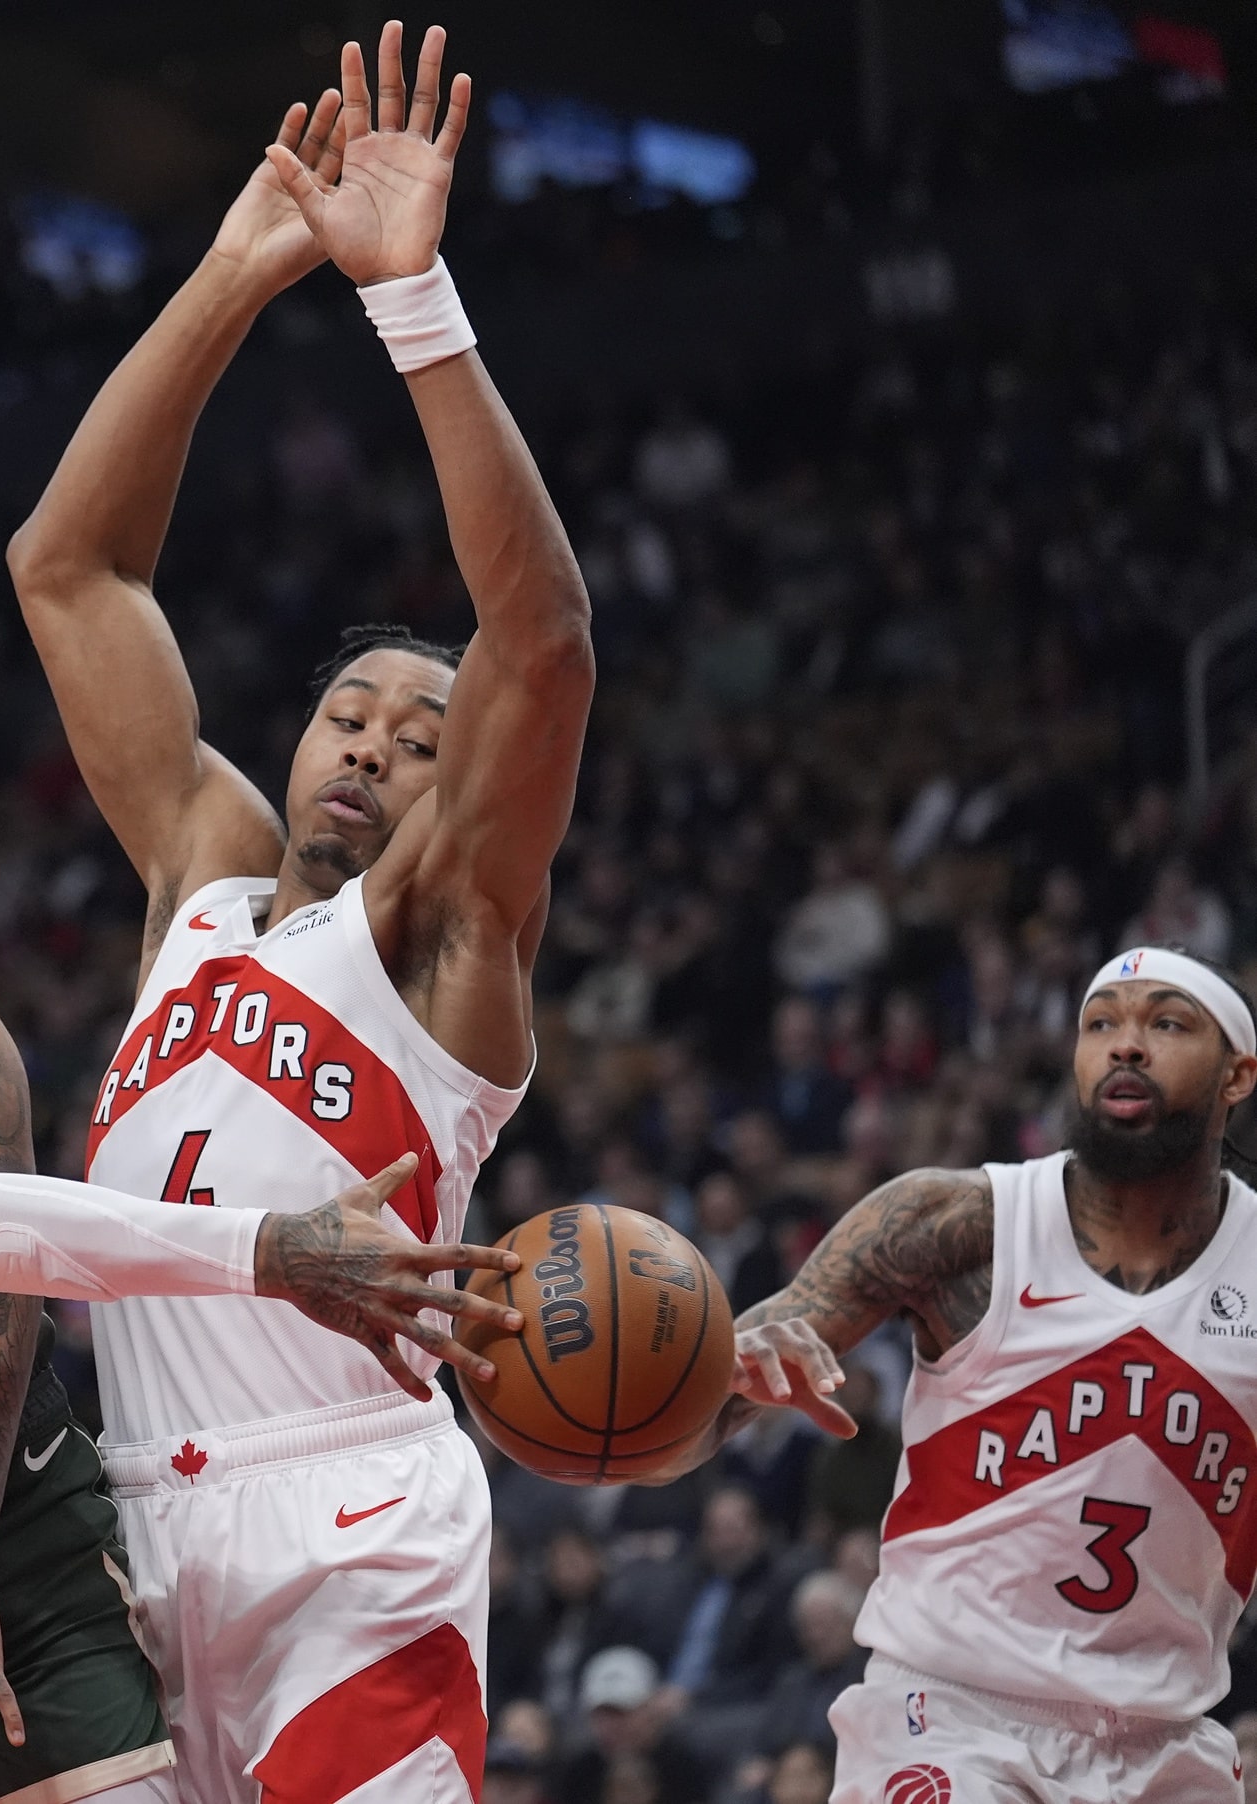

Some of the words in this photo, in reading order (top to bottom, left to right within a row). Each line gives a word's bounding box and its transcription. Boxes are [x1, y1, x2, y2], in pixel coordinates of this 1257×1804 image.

[284, 924, 308, 939] Sun
[311, 910, 334, 928] Life
[93, 981, 354, 1126] RAPTORS
[533, 1207, 594, 1365] Wilson
[1199, 1320, 1227, 1336] Sun
[1231, 1324, 1257, 1339] Life
[974, 1363, 1248, 1515] RAPTORS
[1054, 1496, 1152, 1615] 3
